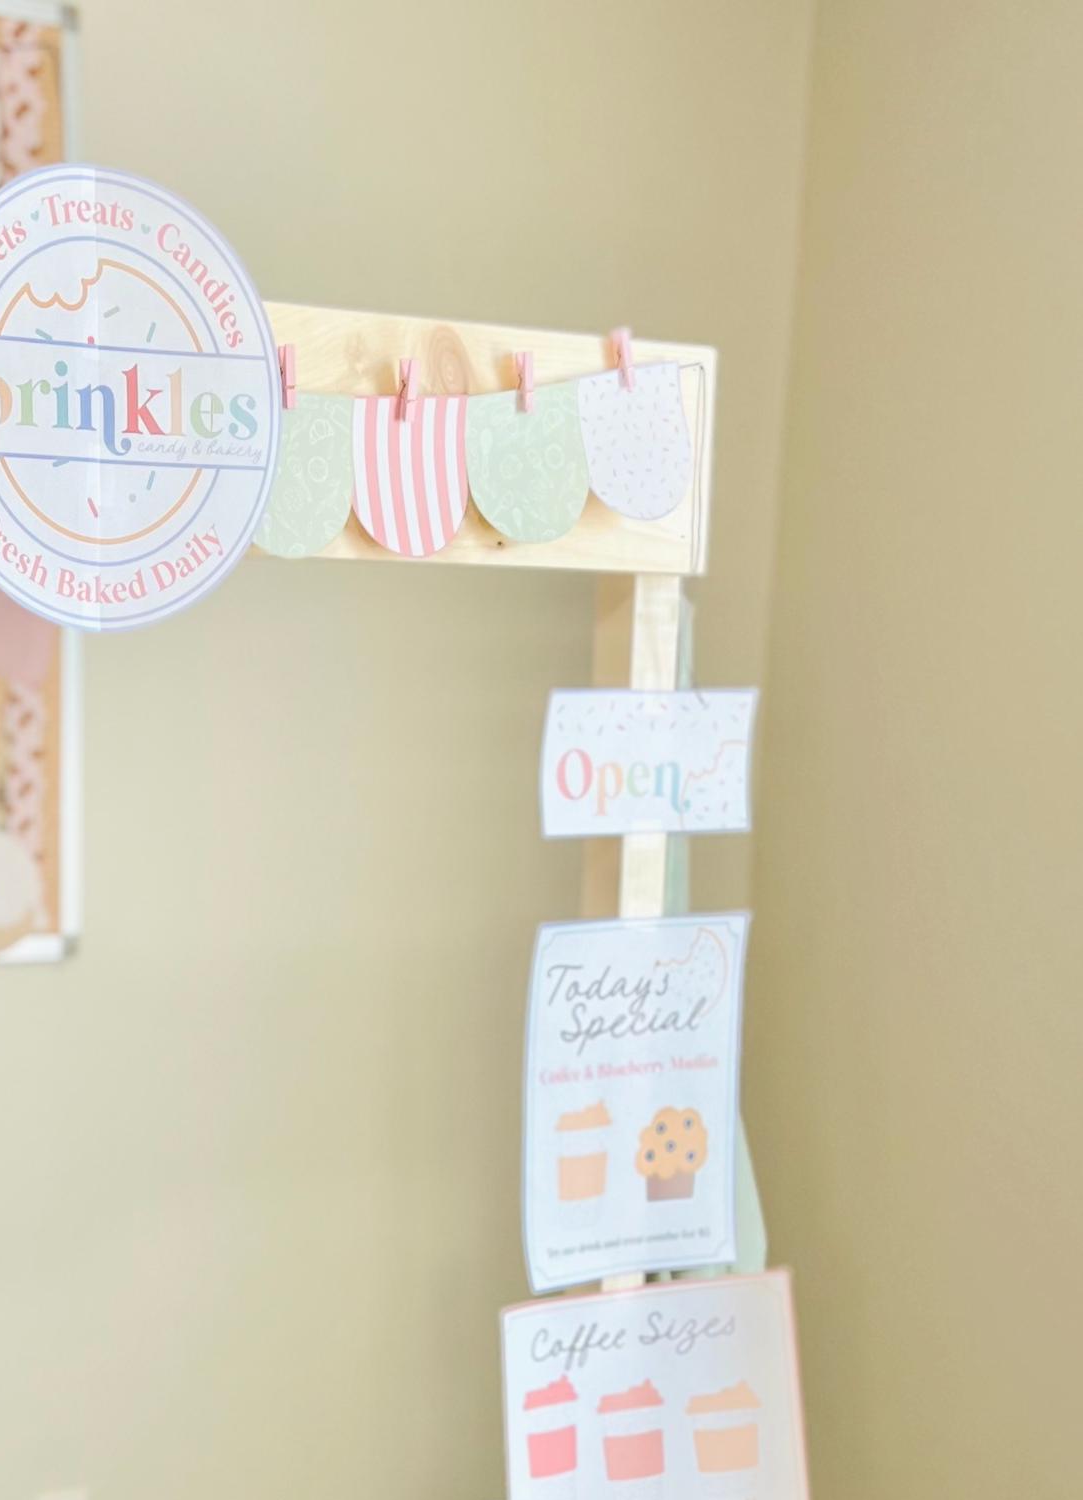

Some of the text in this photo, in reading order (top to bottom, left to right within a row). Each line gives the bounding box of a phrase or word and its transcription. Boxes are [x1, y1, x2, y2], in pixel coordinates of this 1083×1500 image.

[41, 193, 136, 233] Treats
[156, 223, 244, 349] Candies
[137, 439, 263, 464] candy & bakery
[57, 568, 148, 605] Baked
[150, 524, 227, 591] Daily
[556, 747, 692, 817] Open
[560, 997, 707, 1056] Special
[530, 1311, 736, 1371] Coffee Sizes
